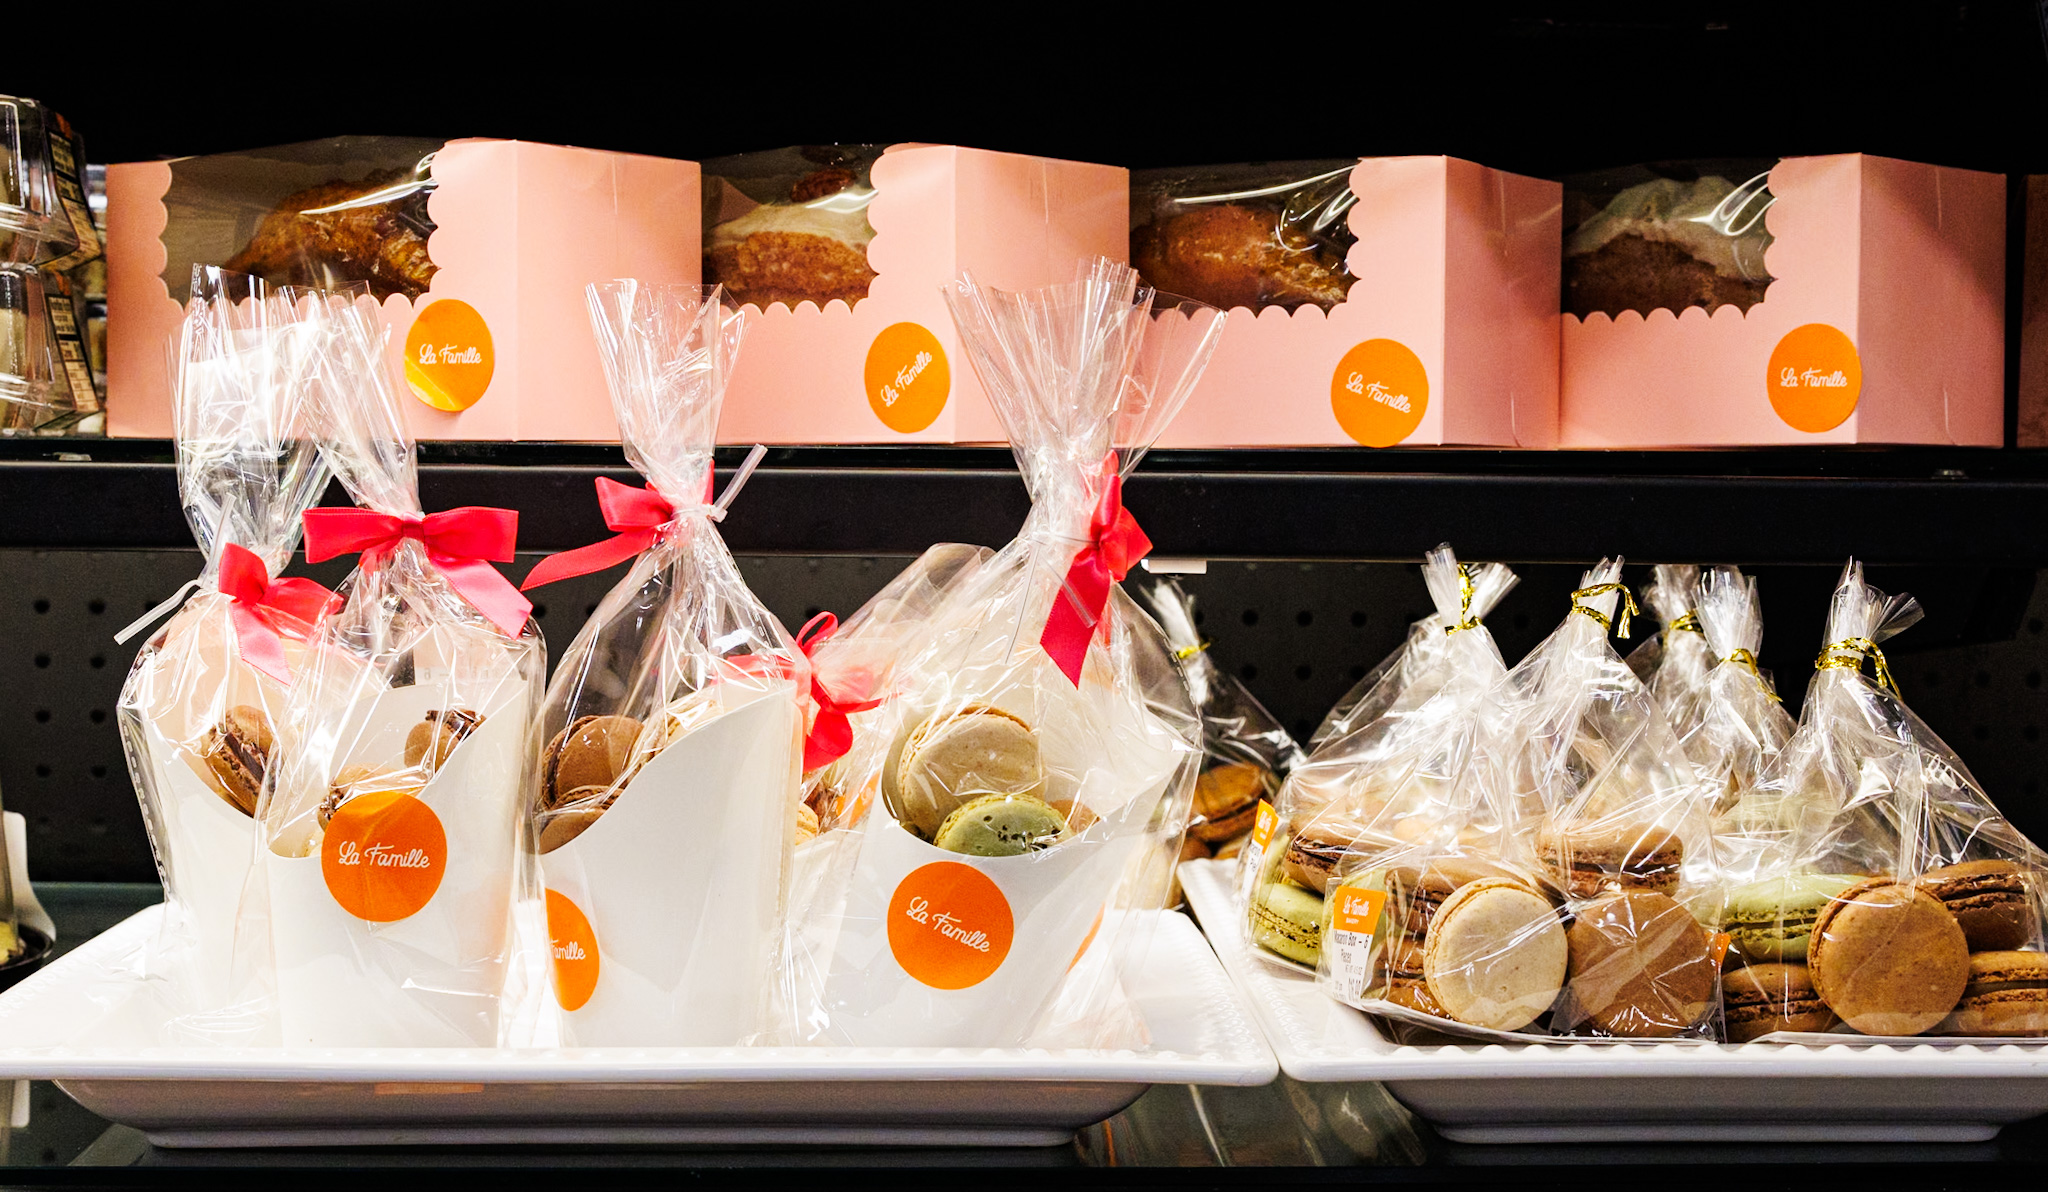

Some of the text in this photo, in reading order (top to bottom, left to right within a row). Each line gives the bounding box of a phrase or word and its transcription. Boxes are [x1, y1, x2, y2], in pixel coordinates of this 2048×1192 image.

[419, 343, 482, 365] La Famille
[880, 351, 933, 407] La Famille
[1345, 371, 1411, 414] La Famille
[1780, 366, 1848, 387] La Famille
[338, 840, 430, 868] La Famille
[906, 896, 990, 953] La Famille
